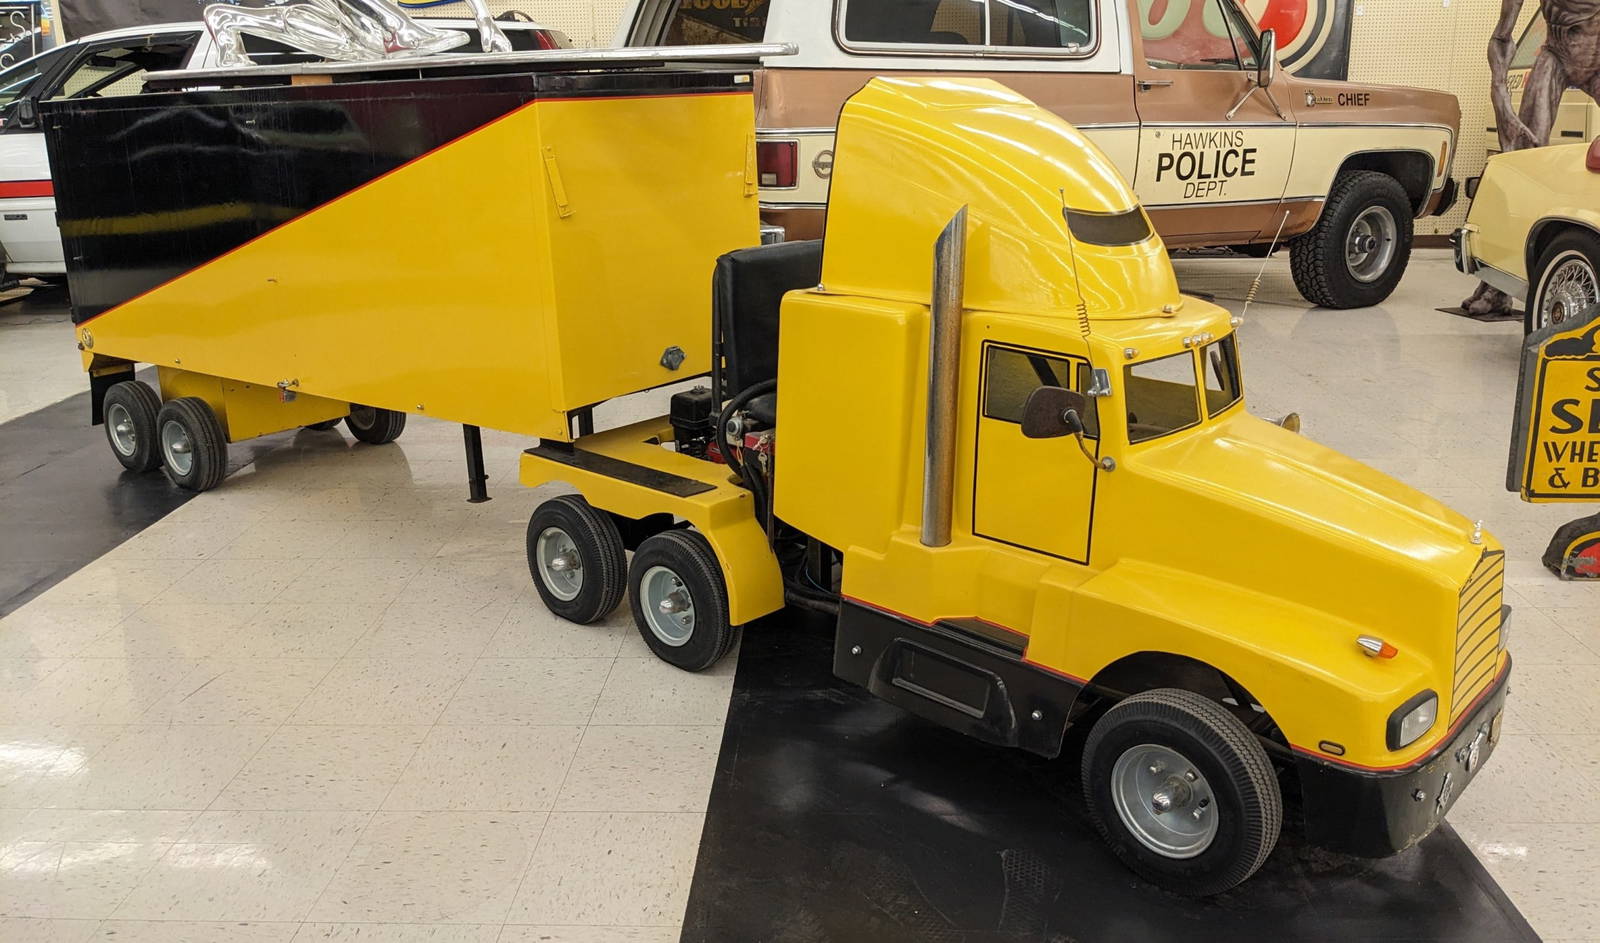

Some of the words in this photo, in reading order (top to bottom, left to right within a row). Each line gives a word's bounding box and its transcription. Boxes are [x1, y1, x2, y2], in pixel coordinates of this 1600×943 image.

[1337, 93, 1370, 106] CHIEF
[1171, 130, 1244, 150] HAWKINS
[1155, 148, 1257, 182] POLICE
[1183, 179, 1227, 199] DEPT.
[1543, 440, 1600, 463] WHE
[1548, 467, 1571, 489] &
